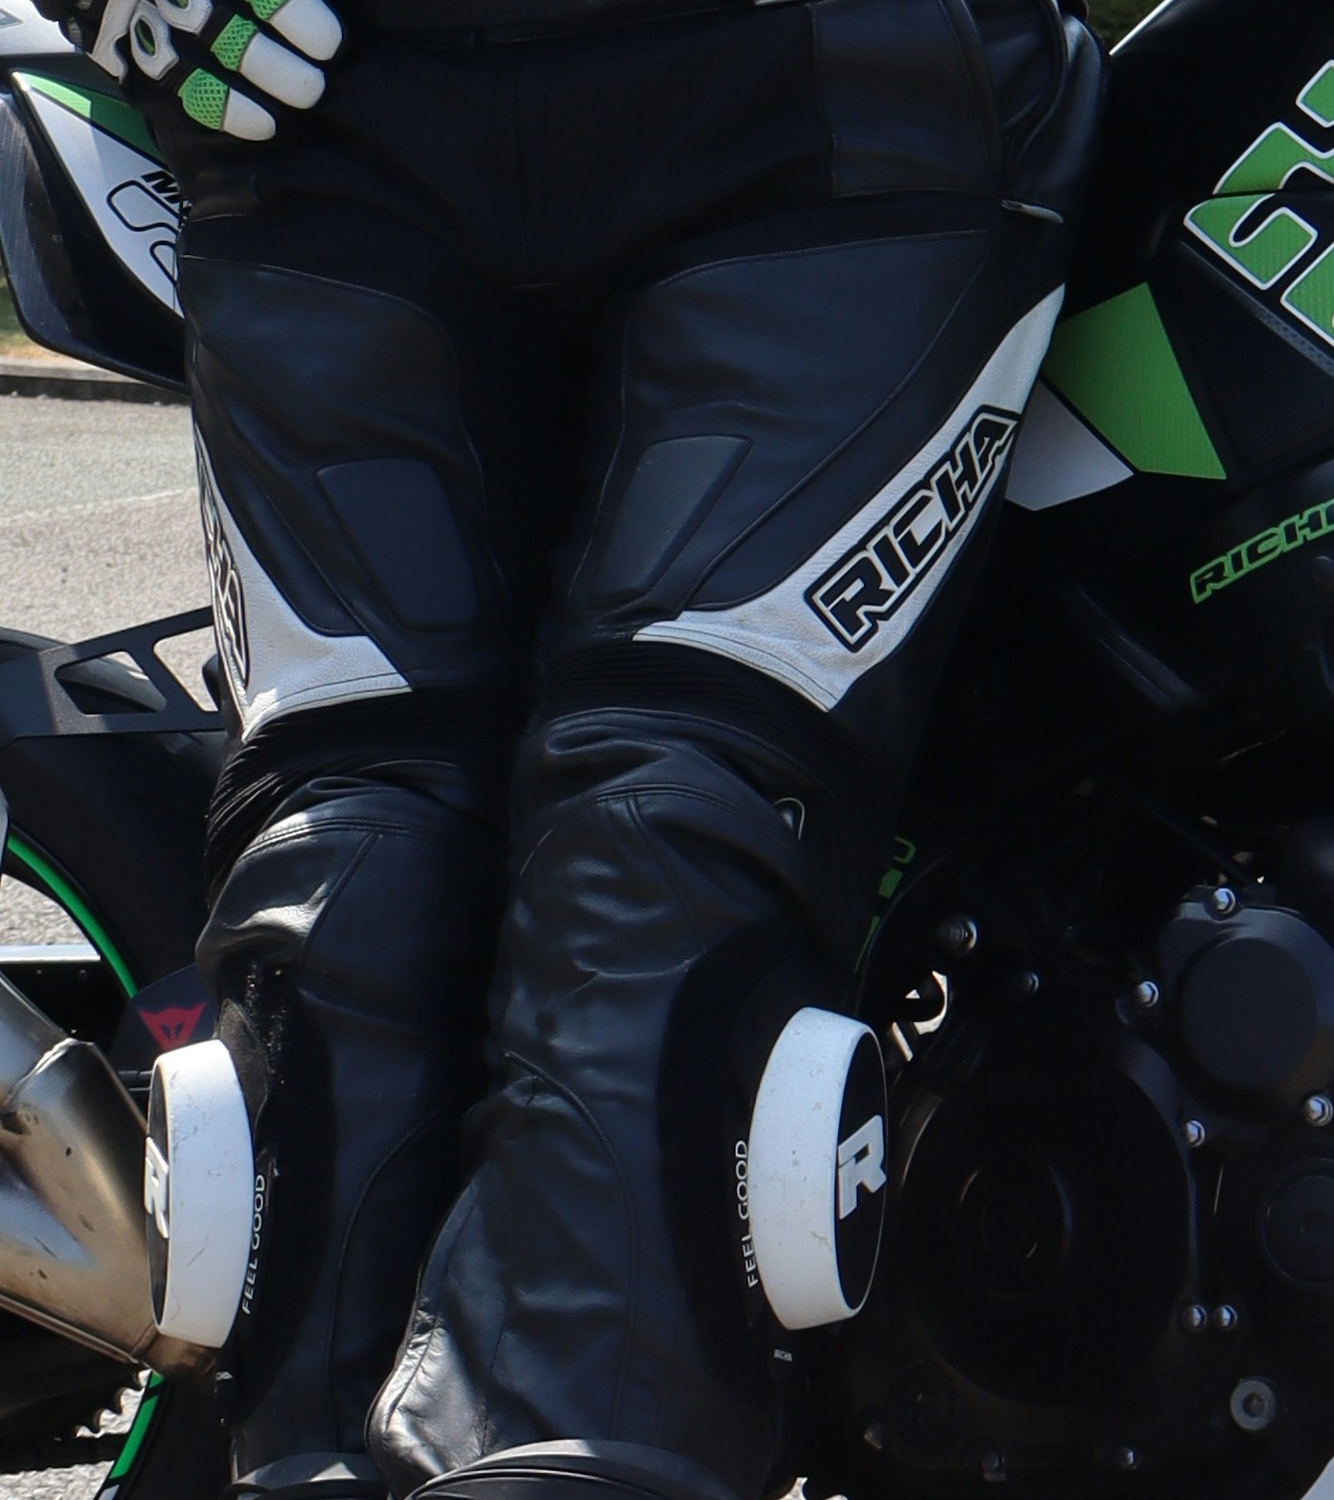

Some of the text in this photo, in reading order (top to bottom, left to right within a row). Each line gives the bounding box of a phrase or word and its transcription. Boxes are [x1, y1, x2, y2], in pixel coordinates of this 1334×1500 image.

[808, 408, 1021, 650] RICHA
[735, 1139, 750, 1220] GOOD
[241, 1257, 259, 1314] FEEL
